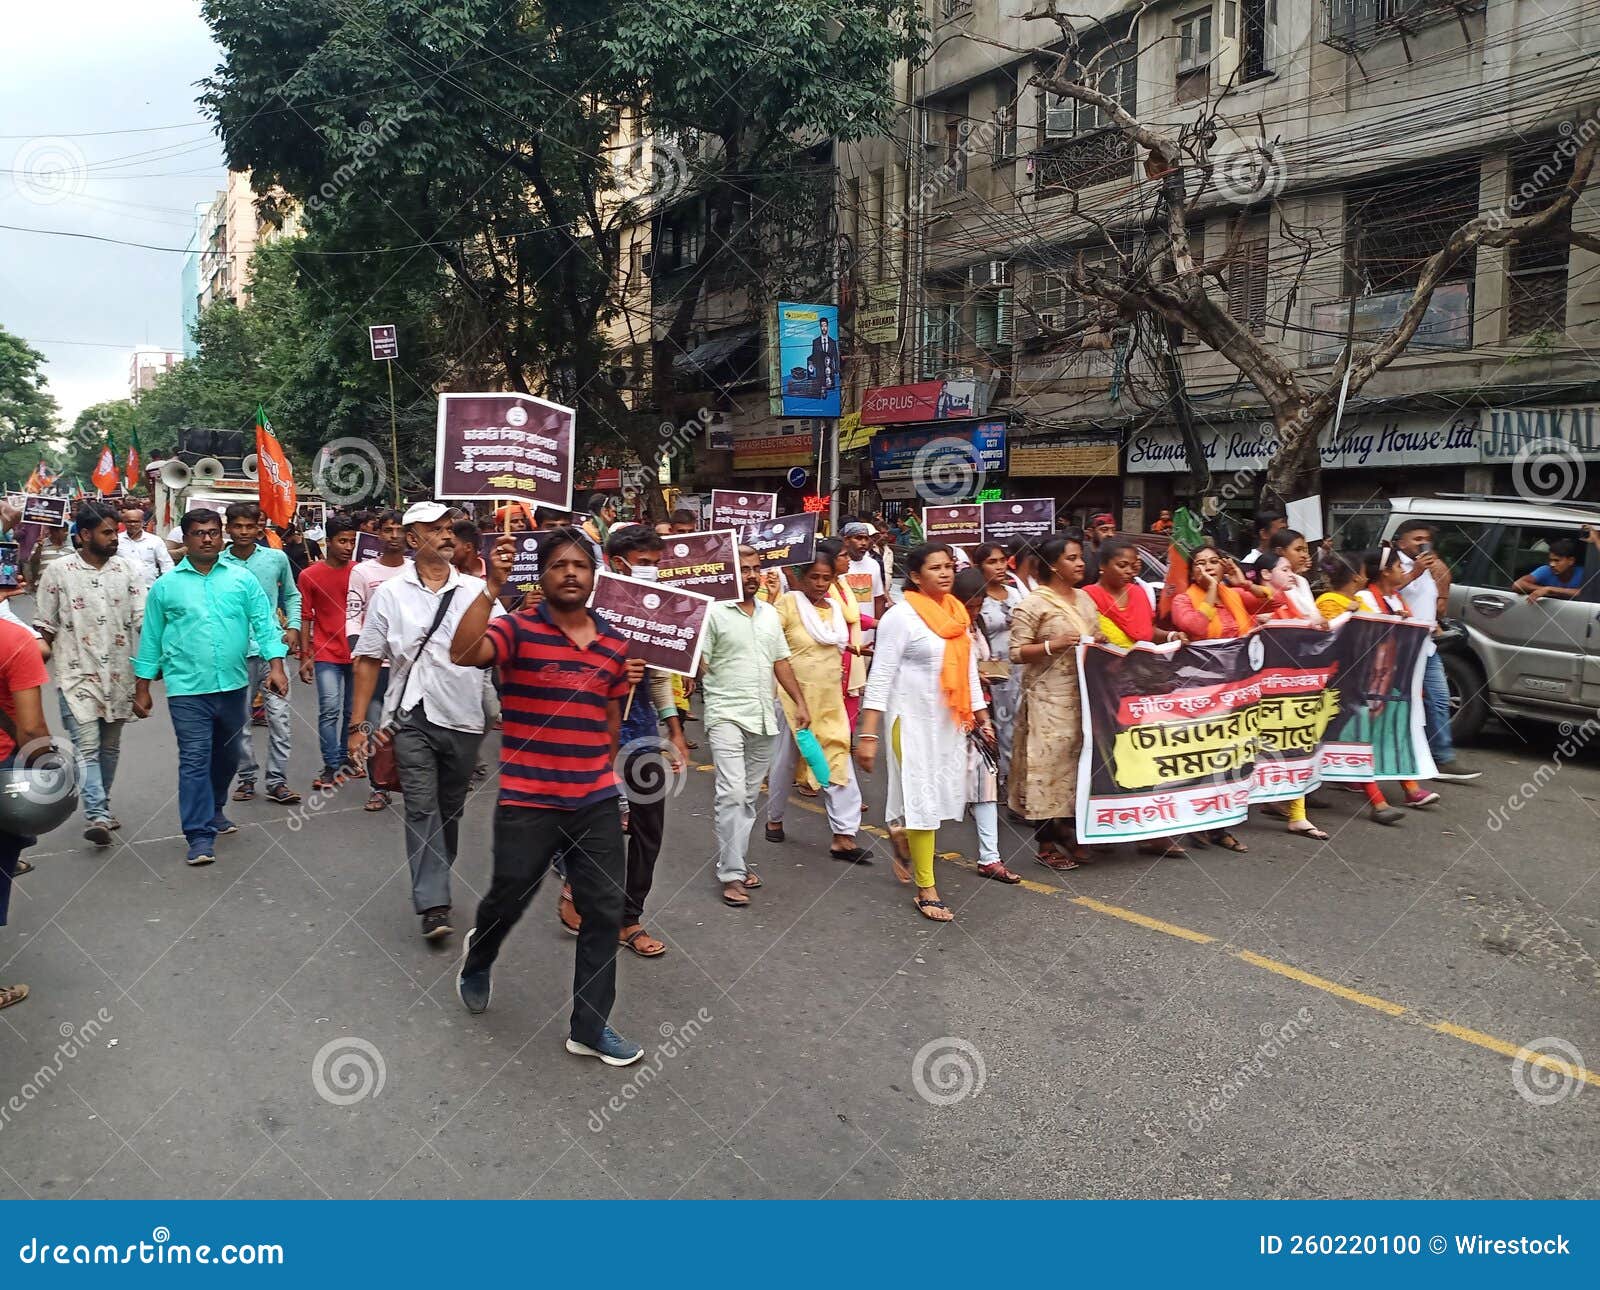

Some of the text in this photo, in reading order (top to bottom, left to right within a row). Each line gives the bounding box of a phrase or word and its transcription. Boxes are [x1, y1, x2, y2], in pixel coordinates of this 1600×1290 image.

[889, 395, 914, 410] PLUS
[1377, 421, 1443, 453] House
[1152, 743, 1239, 778] মমতা
[1096, 795, 1177, 827] বনগাঁ
